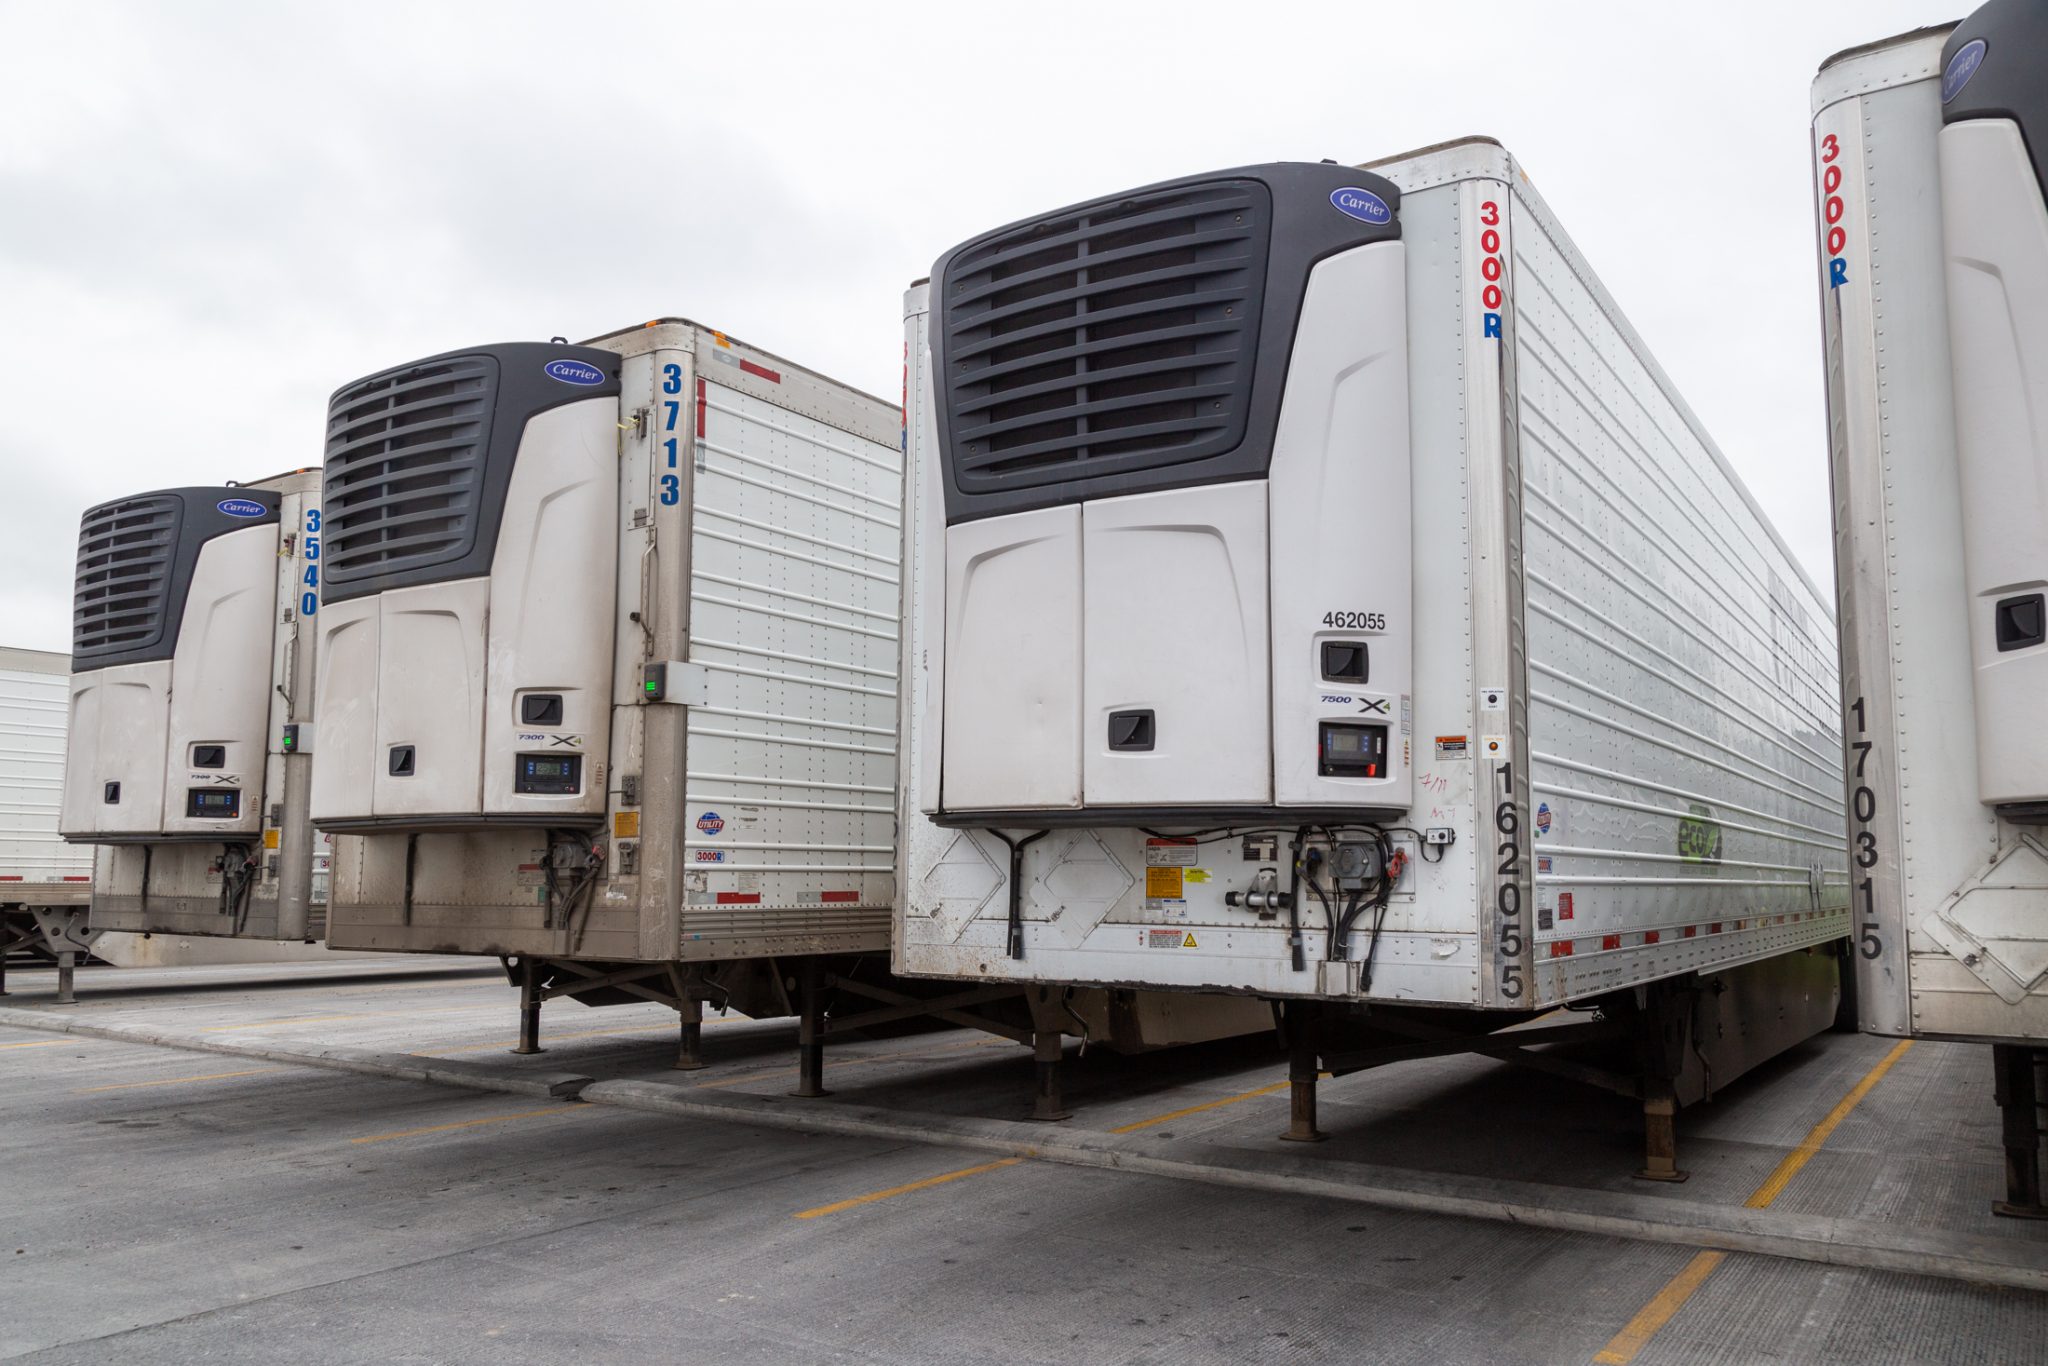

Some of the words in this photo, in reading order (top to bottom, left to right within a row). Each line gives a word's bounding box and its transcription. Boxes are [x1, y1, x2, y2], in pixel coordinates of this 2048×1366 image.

[1340, 193, 1385, 217] Carrier
[1821, 134, 1849, 289] 3000R
[1480, 201, 1503, 339] 3000R
[552, 364, 598, 380] Carrier
[660, 363, 682, 506] 3713
[223, 502, 260, 513] Carrier
[301, 509, 321, 616] 3540
[1322, 611, 1386, 630] 462055
[1321, 695, 1352, 704] 7500
[697, 820, 723, 829] UTILITY
[1850, 696, 1883, 960] 170315
[697, 851, 722, 861] 3000R
[1496, 762, 1523, 999] 162055
